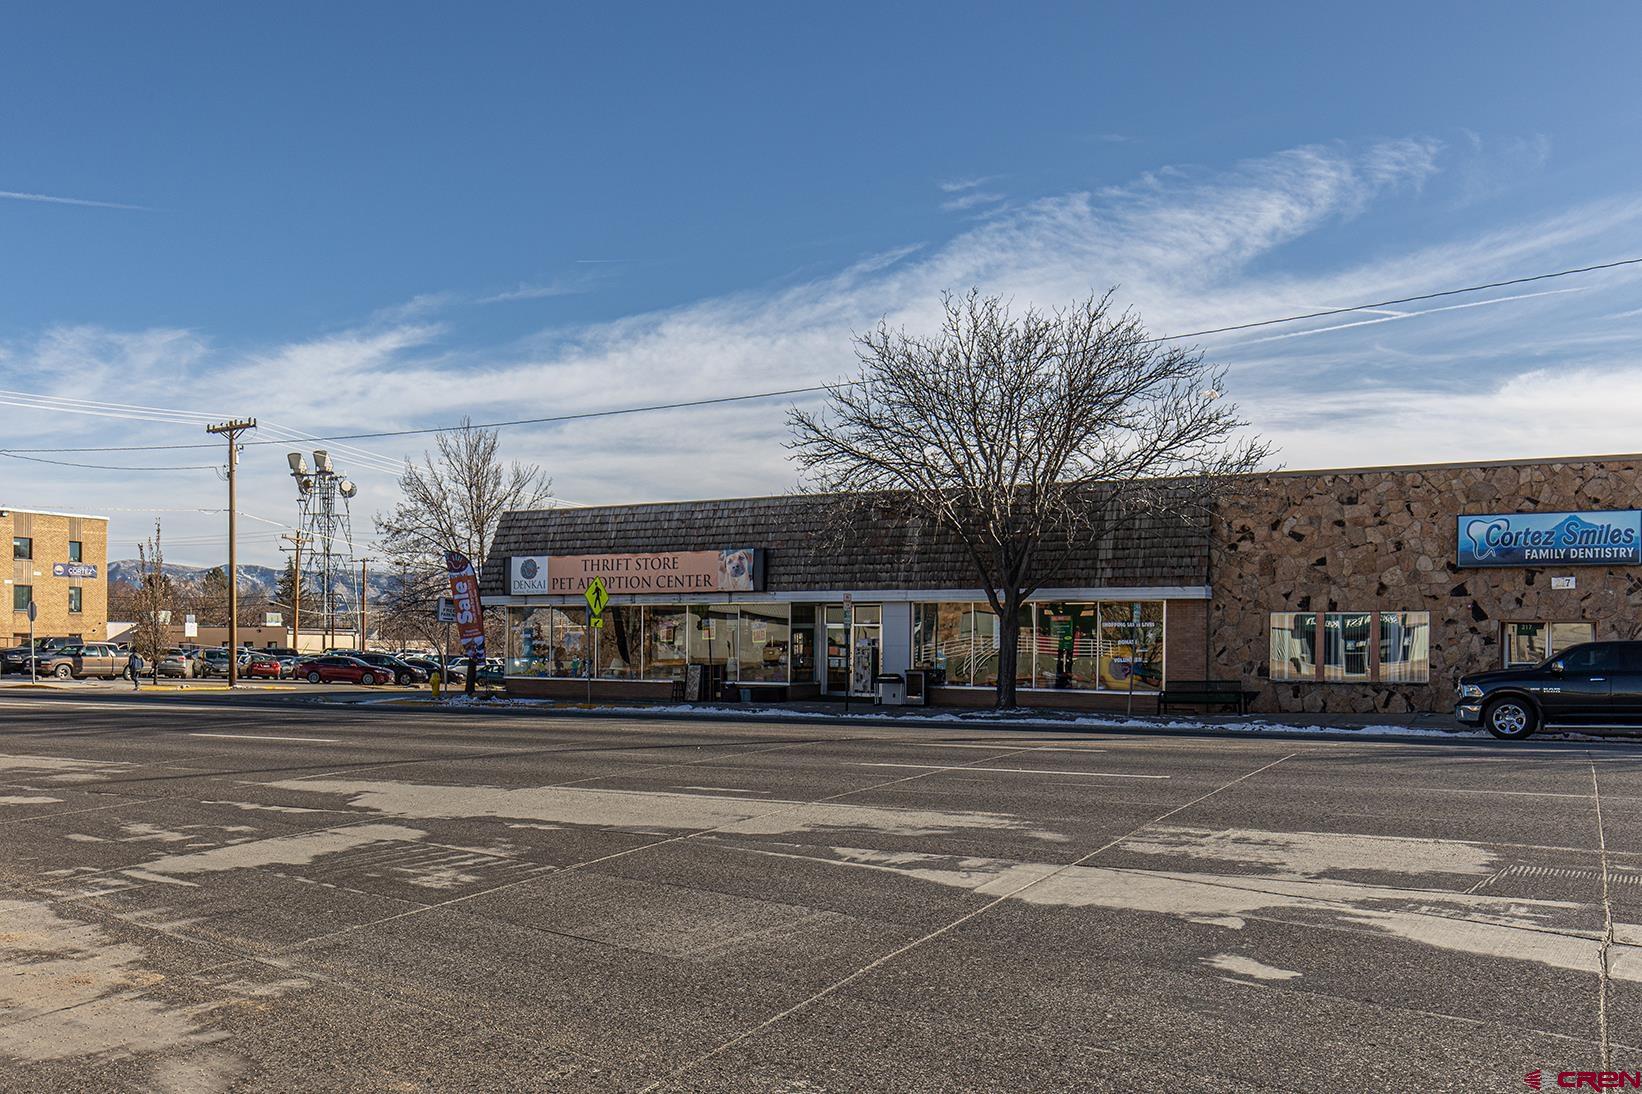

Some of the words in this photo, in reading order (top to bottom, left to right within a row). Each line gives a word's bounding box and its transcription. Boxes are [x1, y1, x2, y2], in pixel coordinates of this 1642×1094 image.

[1485, 523, 1555, 547] Cortez
[1561, 520, 1635, 546] Smiles
[1524, 548, 1566, 560] FAMILY
[1570, 547, 1634, 559] DENTISTRY
[581, 558, 632, 572] THRIFT
[635, 556, 679, 570] STORE
[513, 579, 546, 590] DENKAI
[552, 577, 574, 590] PET
[656, 574, 713, 588] CENTER
[454, 581, 473, 624] Sale
